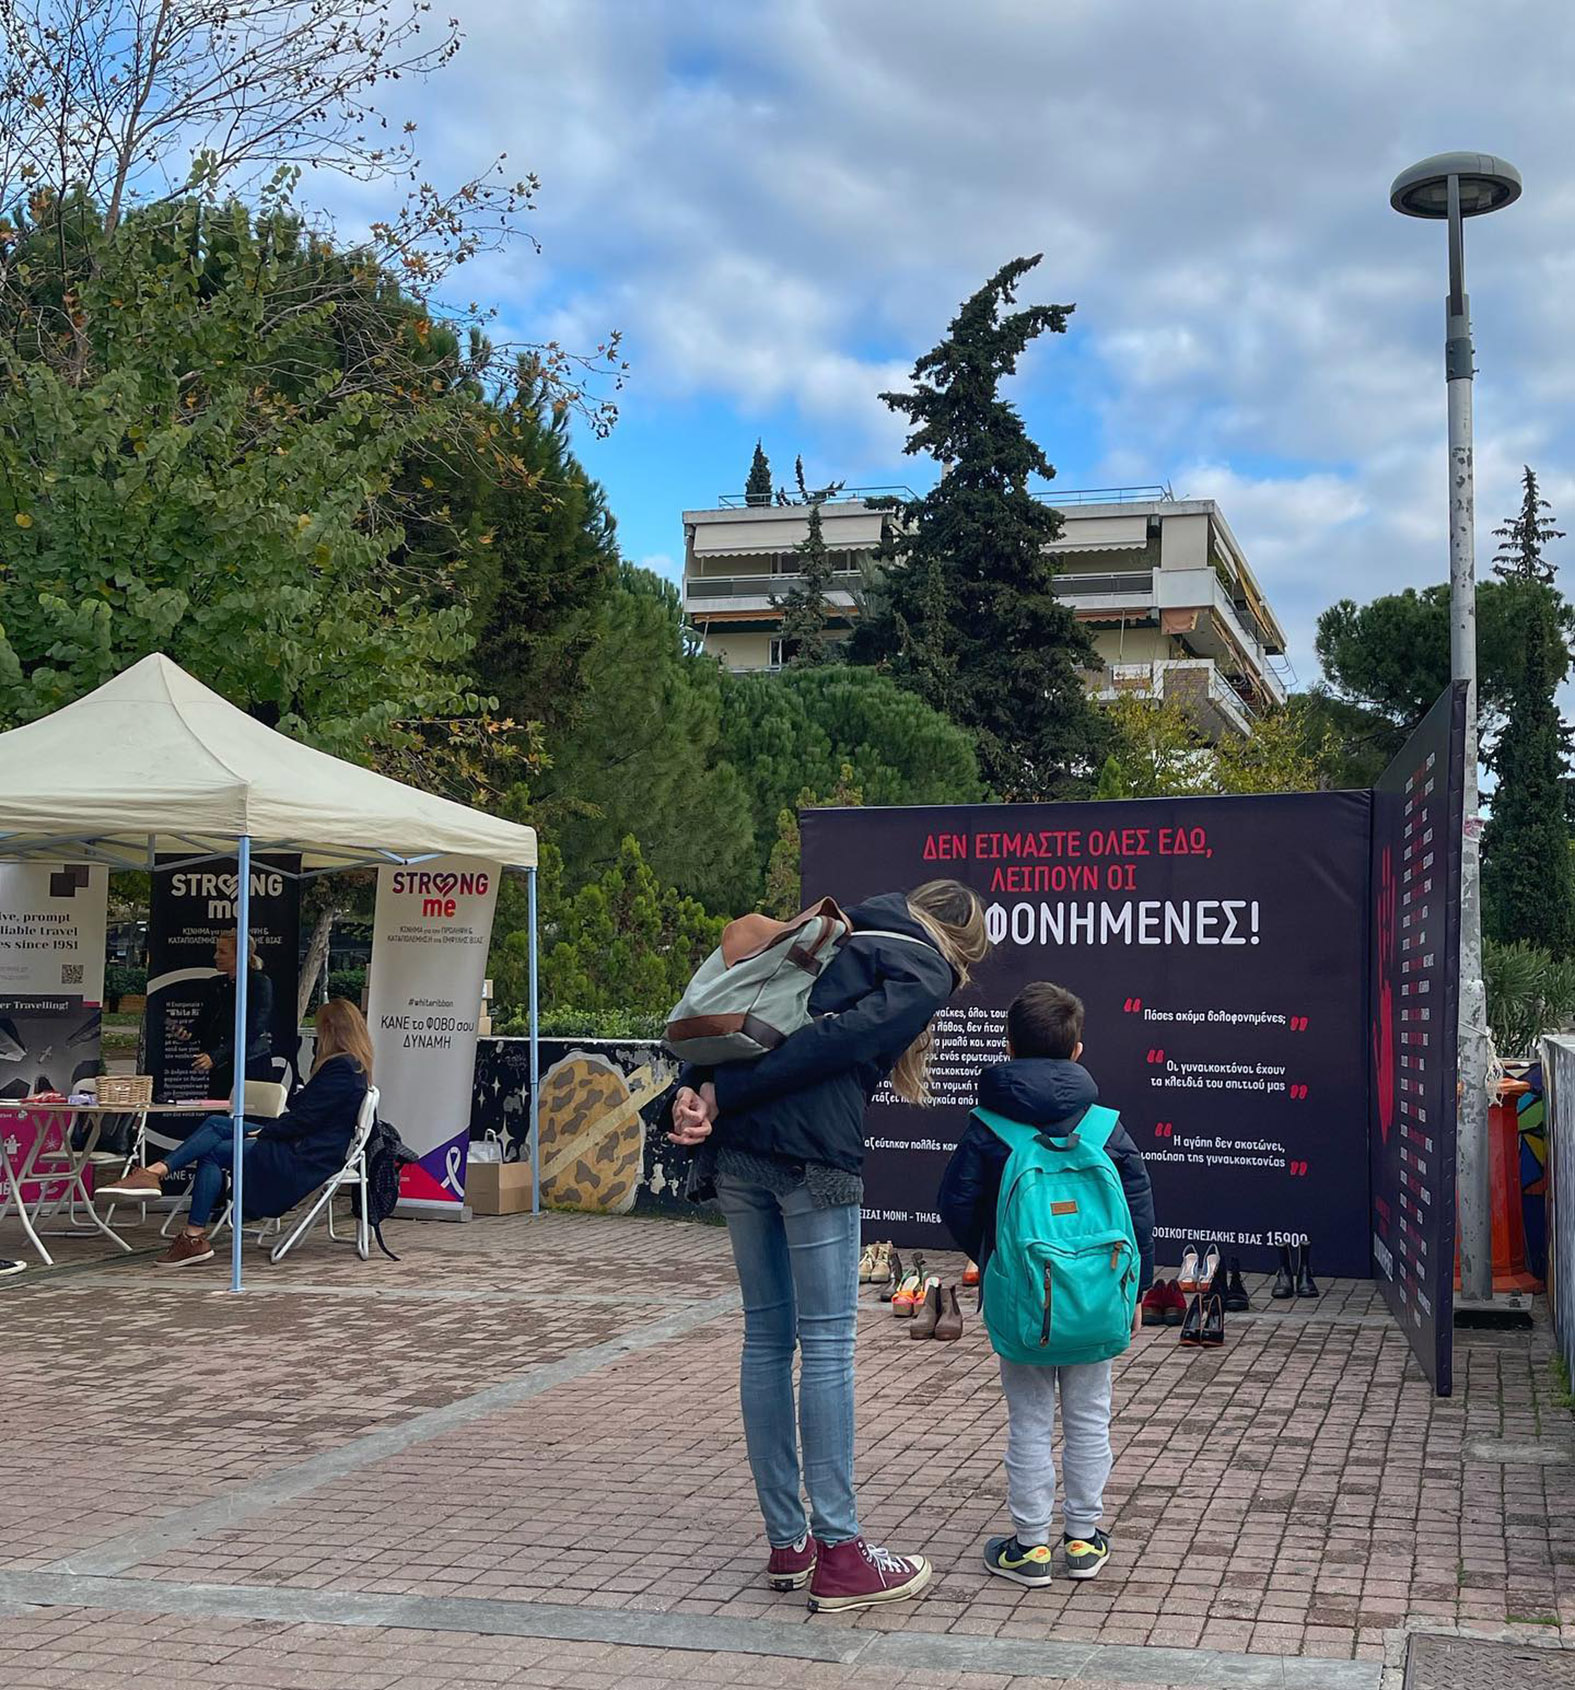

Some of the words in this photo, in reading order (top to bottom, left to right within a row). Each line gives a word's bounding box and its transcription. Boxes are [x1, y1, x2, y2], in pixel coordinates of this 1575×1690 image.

[923, 833, 967, 860] ΔΕΝ
[975, 830, 1081, 858] ΕΙΜΑΣΤΕ
[1089, 829, 1150, 856] ΟΛΕΣ
[1159, 827, 1214, 858] ΕΔΩ,
[991, 866, 1098, 892] ΛΕΙΠΟΥΝ
[1107, 864, 1137, 890] ΟΙ
[422, 898, 456, 917] me
[23, 912, 70, 924] prompt
[984, 900, 1260, 945] ΦΟΝΗΜΕΝΕΣ!
[0, 924, 37, 936] liable
[40, 926, 78, 936] travel
[15, 938, 49, 949] since
[53, 939, 78, 950] 1981
[13, 1001, 69, 1011] Travelling!
[934, 1007, 966, 1019] ναίκες,
[968, 1007, 988, 1018] όλοι
[381, 1016, 410, 1030] ΚΑΝΕ
[412, 1020, 424, 1030] το
[426, 1017, 455, 1031] ΦΟΒΟ
[456, 1022, 475, 1031] σου
[1144, 1009, 1173, 1021] Πόσες
[1175, 1010, 1205, 1024] ακόμα
[1207, 1010, 1286, 1026] δολοφονημένες;
[937, 1021, 965, 1034] λάθος,
[966, 1021, 982, 1032] δεν
[983, 1022, 1005, 1033] ήταν
[403, 1035, 451, 1049] ΔΥΝΑΜΗ
[941, 1036, 968, 1049] μυαλό
[969, 1038, 985, 1047] και
[986, 1037, 1008, 1047] κανέ
[940, 1051, 960, 1061] ενός
[1166, 1060, 1179, 1072] Οι
[1180, 1062, 1254, 1075] γυναικοκτόνοι
[1256, 1063, 1286, 1075] έχουν
[942, 1080, 972, 1093] νομική
[1151, 1077, 1163, 1087] τα
[1164, 1076, 1204, 1088] κλειδιά
[1205, 1079, 1224, 1088] του
[1225, 1079, 1265, 1091] σπιτιού
[1267, 1082, 1286, 1093] μας
[958, 1095, 974, 1106] από
[864, 1137, 909, 1150] αζεύτηκαν
[911, 1139, 941, 1151] πολλές
[1173, 1135, 1182, 1147] Η
[1183, 1135, 1213, 1150] αγάπη
[1215, 1137, 1233, 1149] δεν
[1234, 1138, 1286, 1153] σκοτώνει,
[1140, 1150, 1185, 1162] ιοποίηση
[1187, 1153, 1204, 1163] της
[1206, 1155, 1286, 1168] γυναικοκτονίας
[883, 1210, 908, 1221] ΜΟΝΗ
[1152, 1226, 1236, 1243] ΟΟΙΚΟΓΕΝΕΙΑΚΗΣ
[1238, 1233, 1263, 1245] ΒΙΑΣ
